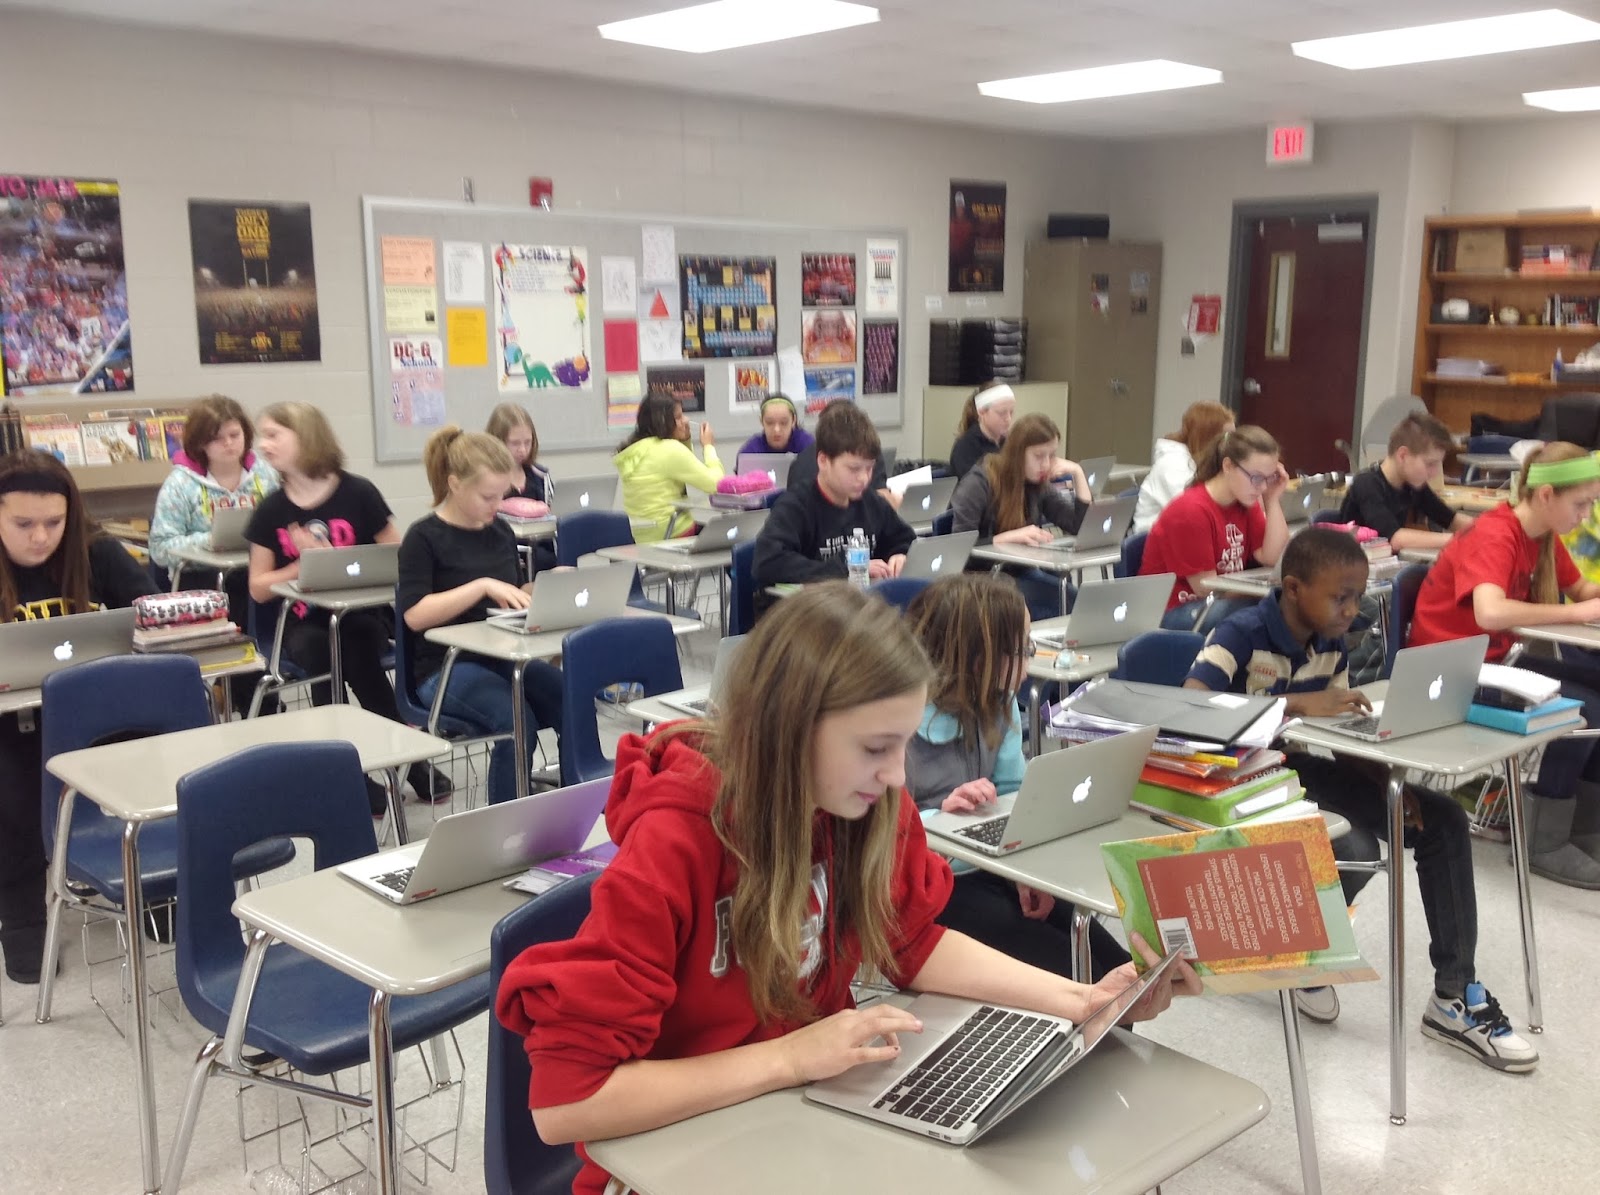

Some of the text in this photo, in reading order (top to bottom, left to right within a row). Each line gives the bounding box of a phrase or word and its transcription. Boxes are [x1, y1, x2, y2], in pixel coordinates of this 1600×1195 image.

[1273, 127, 1305, 159] EXIT
[236, 214, 269, 226] ONLY
[519, 247, 562, 261] SCIENCE
[393, 341, 430, 358] DC-G
[400, 356, 437, 368] Schools
[1228, 853, 1242, 882] SLEEPING
[1252, 871, 1261, 886] MAD
[1185, 885, 1197, 910] YELLOW
[1191, 910, 1202, 929] FEVER
[1195, 883, 1214, 930] TYPHOID FEVER
[1203, 869, 1229, 941] TRANSMITTED DISEASES
[1208, 858, 1240, 950] SYPHILIS AND OTHER SEXUALLY
[1221, 858, 1251, 949] PARASITIC TROPICAL DISEASES
[1236, 883, 1250, 913] SICKNESS
[1257, 886, 1266, 902] COW
[1260, 853, 1289, 943] LEPROSY (HANSEN'S DISEASE)
[1274, 860, 1299, 934] LEGIONNAIRE'S DISEASE
[1292, 885, 1304, 906] EBOLA
[1245, 914, 1254, 928] AND
[1261, 903, 1273, 929] DISEASE
[1249, 929, 1260, 950] OTHER
